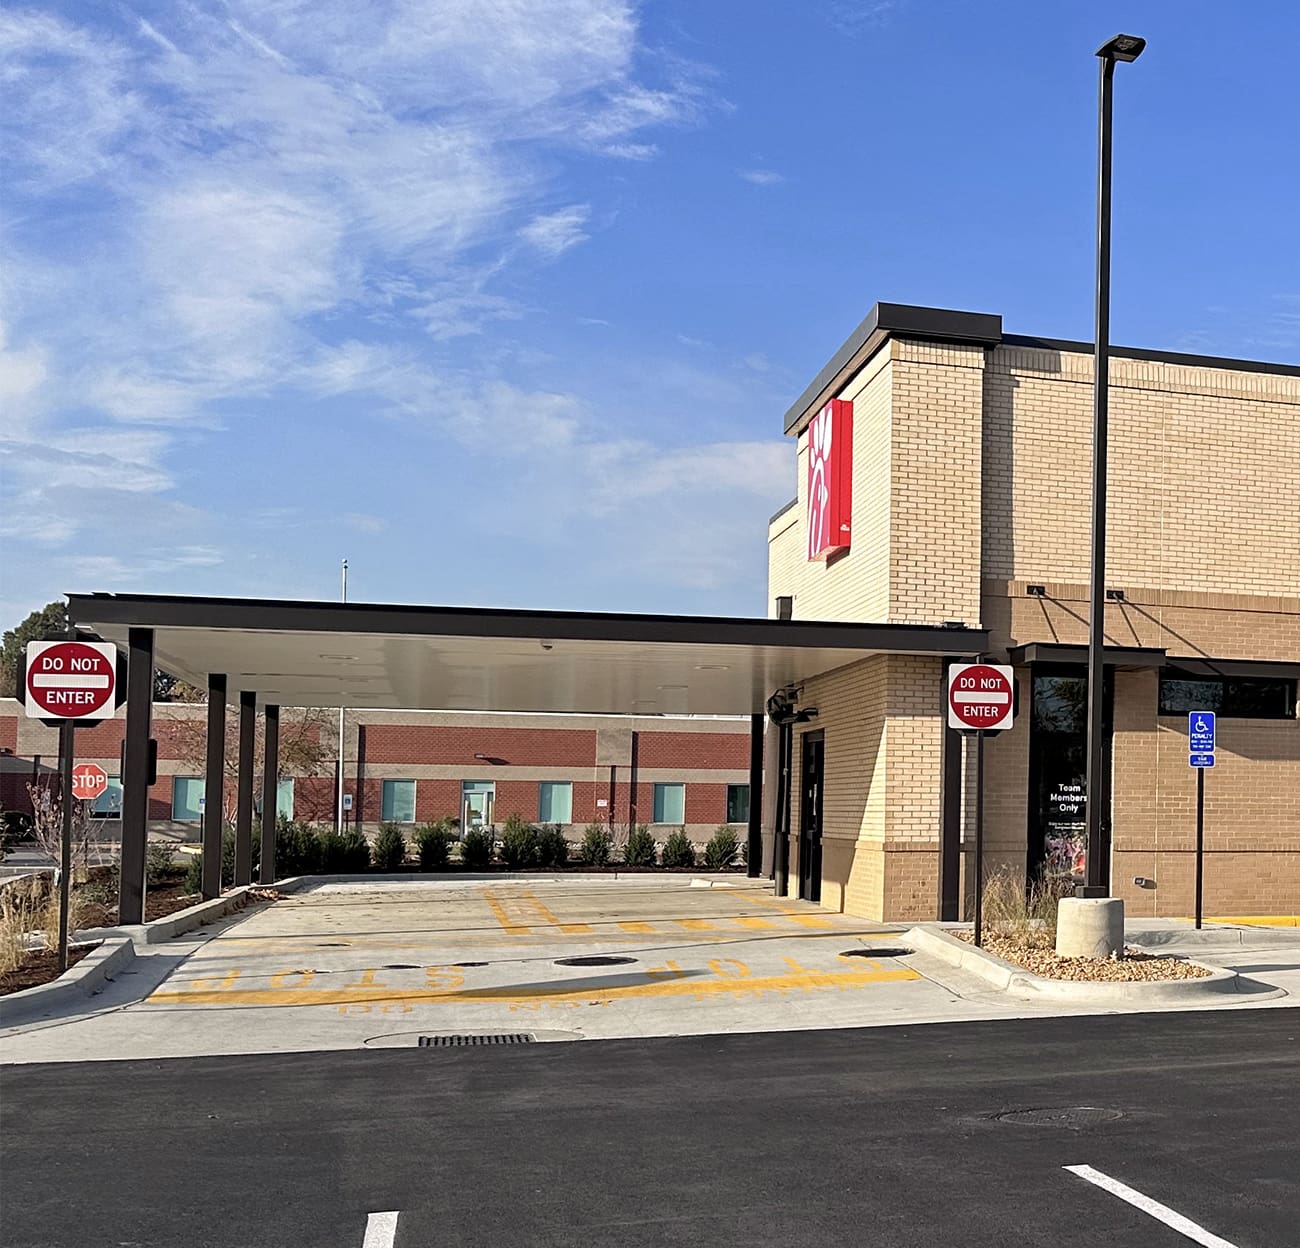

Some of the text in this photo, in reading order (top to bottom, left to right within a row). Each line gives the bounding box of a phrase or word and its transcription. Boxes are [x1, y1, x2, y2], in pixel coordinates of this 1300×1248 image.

[42, 657, 100, 671] DO NOT
[960, 677, 1002, 689] DO NOT
[46, 691, 95, 704] ENTER
[963, 705, 999, 718] ENTER
[72, 775, 105, 788] STOP
[1058, 783, 1081, 792] Team
[1050, 793, 1088, 802] Members
[1059, 803, 1079, 814] Only
